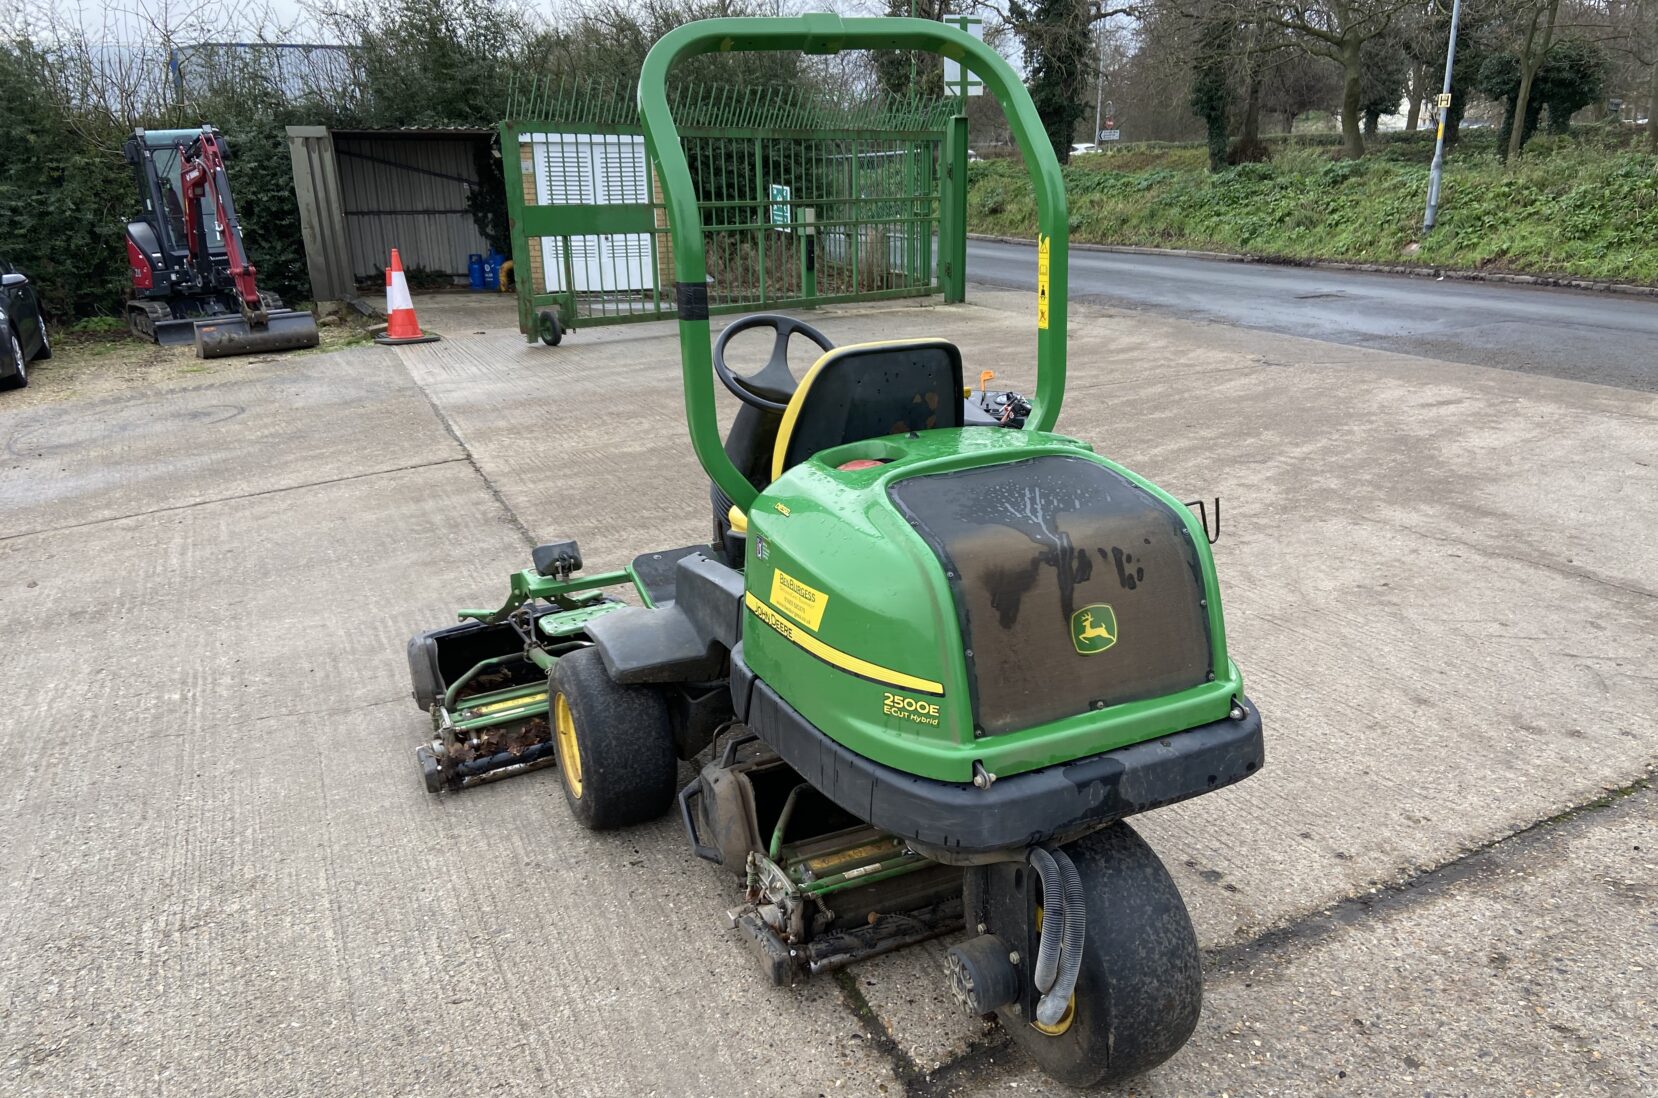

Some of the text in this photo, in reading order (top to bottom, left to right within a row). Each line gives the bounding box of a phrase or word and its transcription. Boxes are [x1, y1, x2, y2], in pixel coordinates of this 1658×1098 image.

[1439, 95, 1450, 106] H
[789, 579, 816, 603] BURGESS
[754, 604, 771, 624] JOHN
[771, 614, 793, 638] DEERE
[884, 692, 940, 716] 2500E
[910, 713, 938, 725] Hybrid
